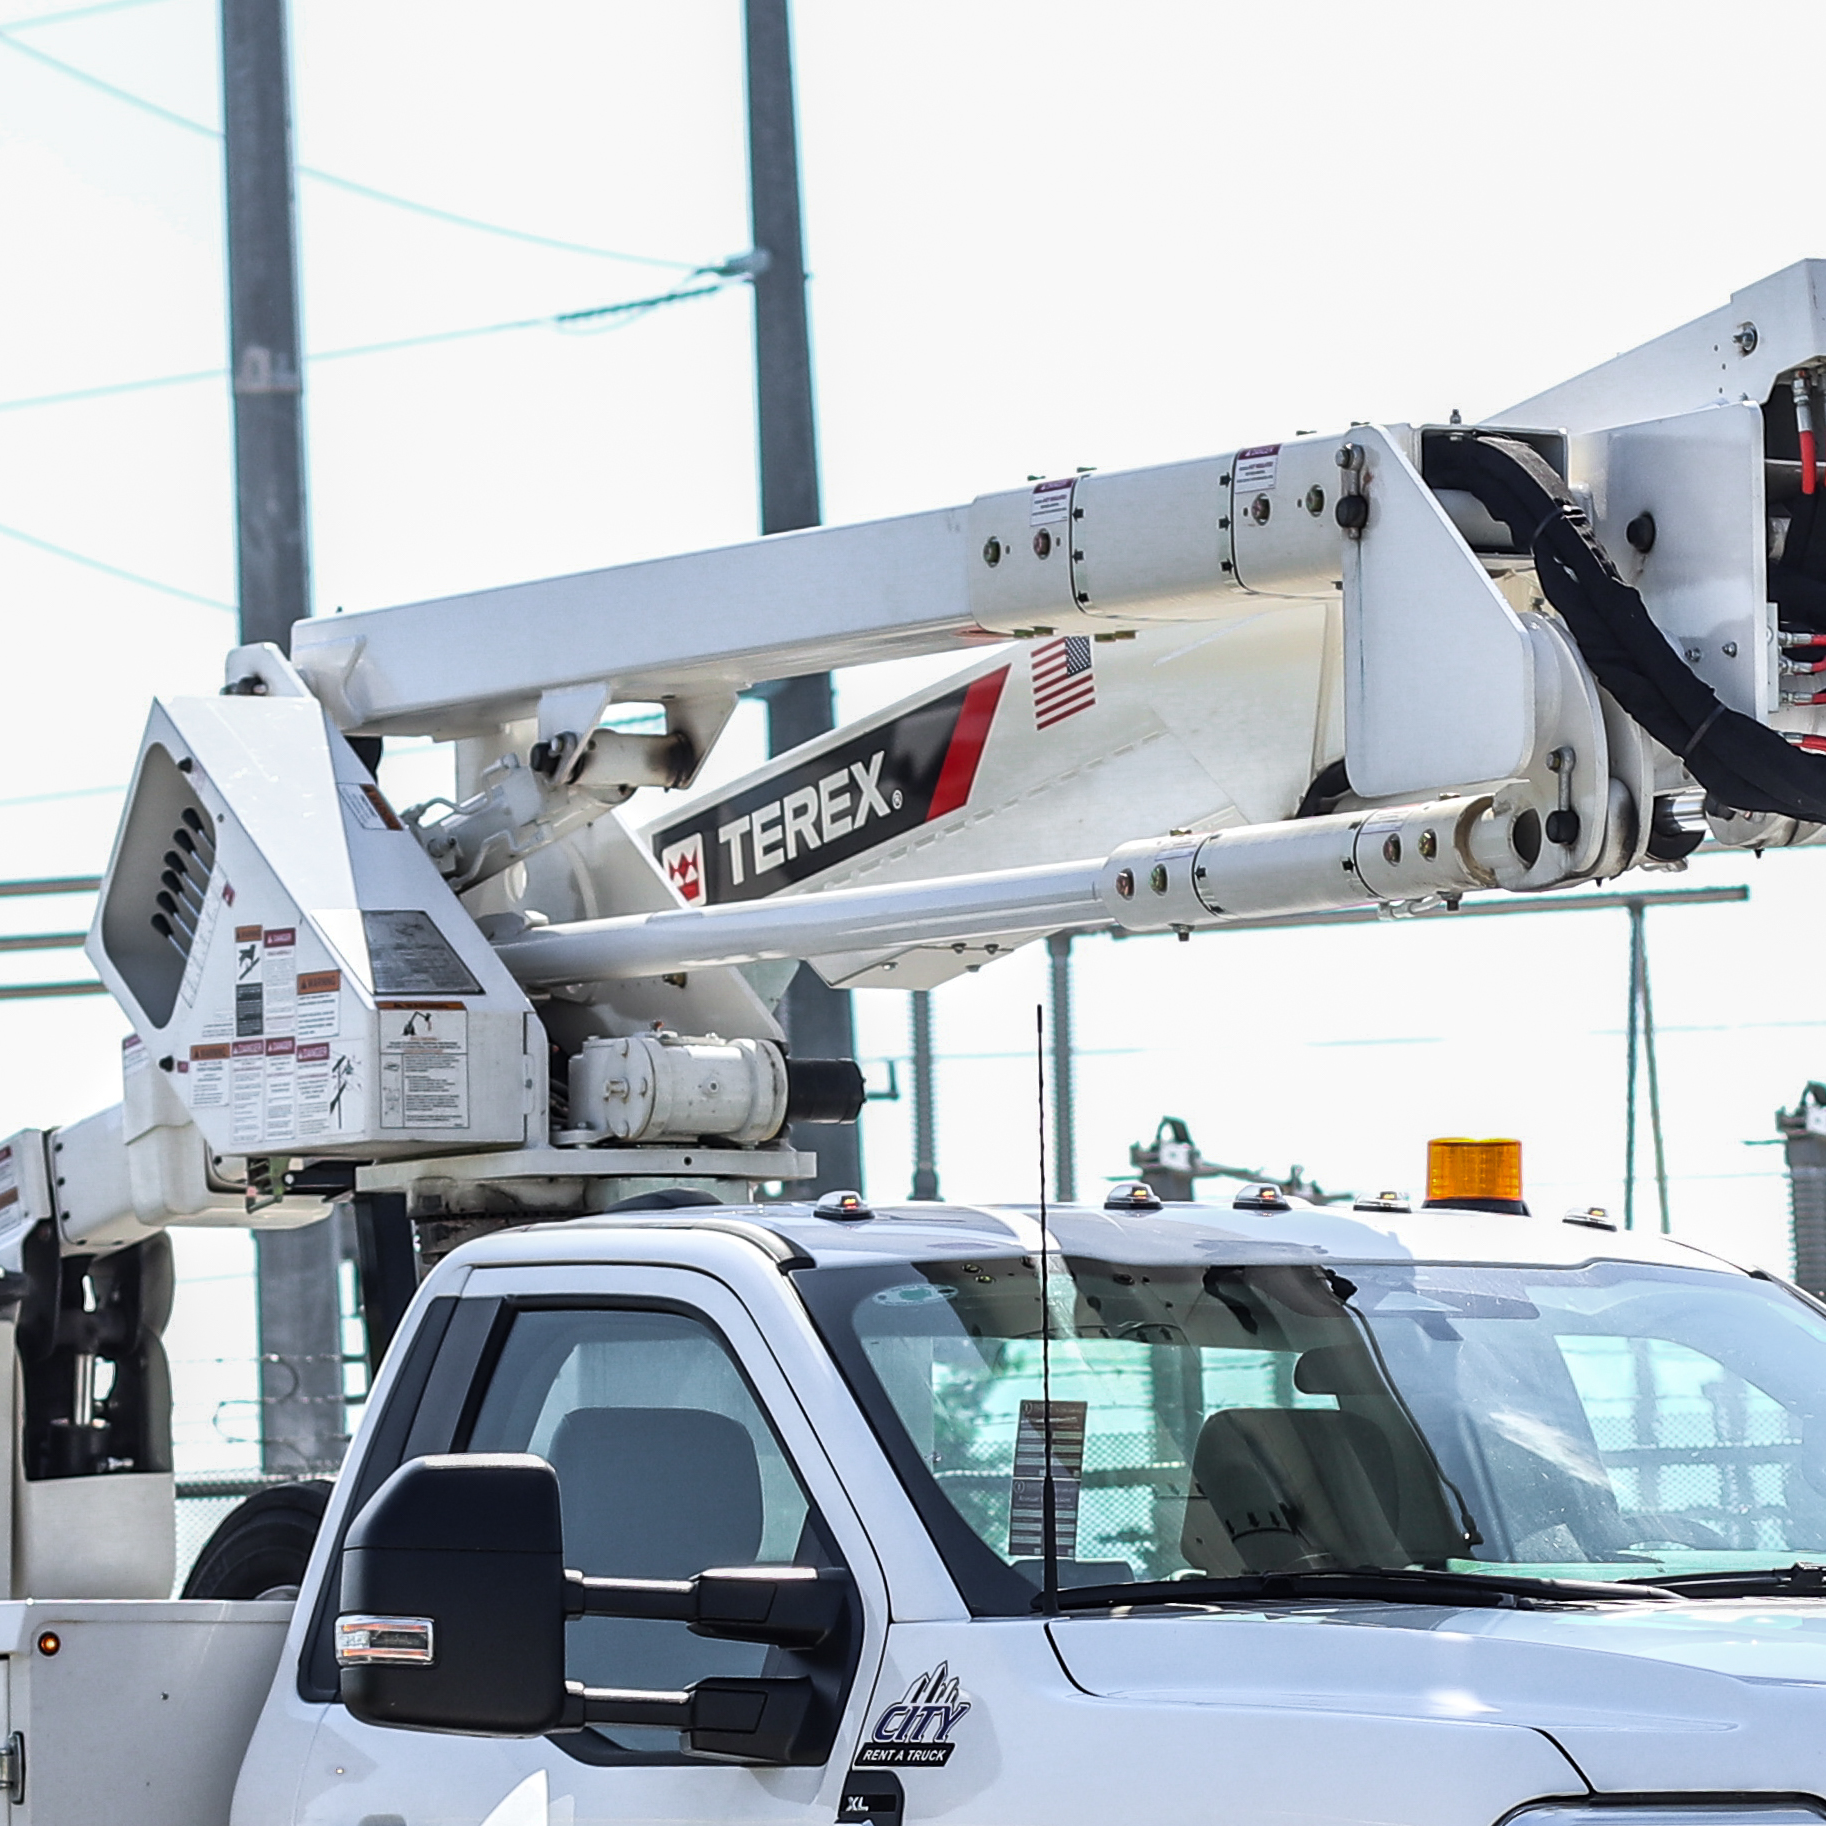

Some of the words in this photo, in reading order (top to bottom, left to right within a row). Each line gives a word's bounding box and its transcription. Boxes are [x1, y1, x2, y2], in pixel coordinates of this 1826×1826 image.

[718, 751, 892, 886] TEREX
[873, 1703, 971, 1742] CITY
[862, 1749, 896, 1761] RENT
[894, 1749, 905, 1761] A
[907, 1749, 947, 1761] TRUCK
[845, 1796, 869, 1812] XL
